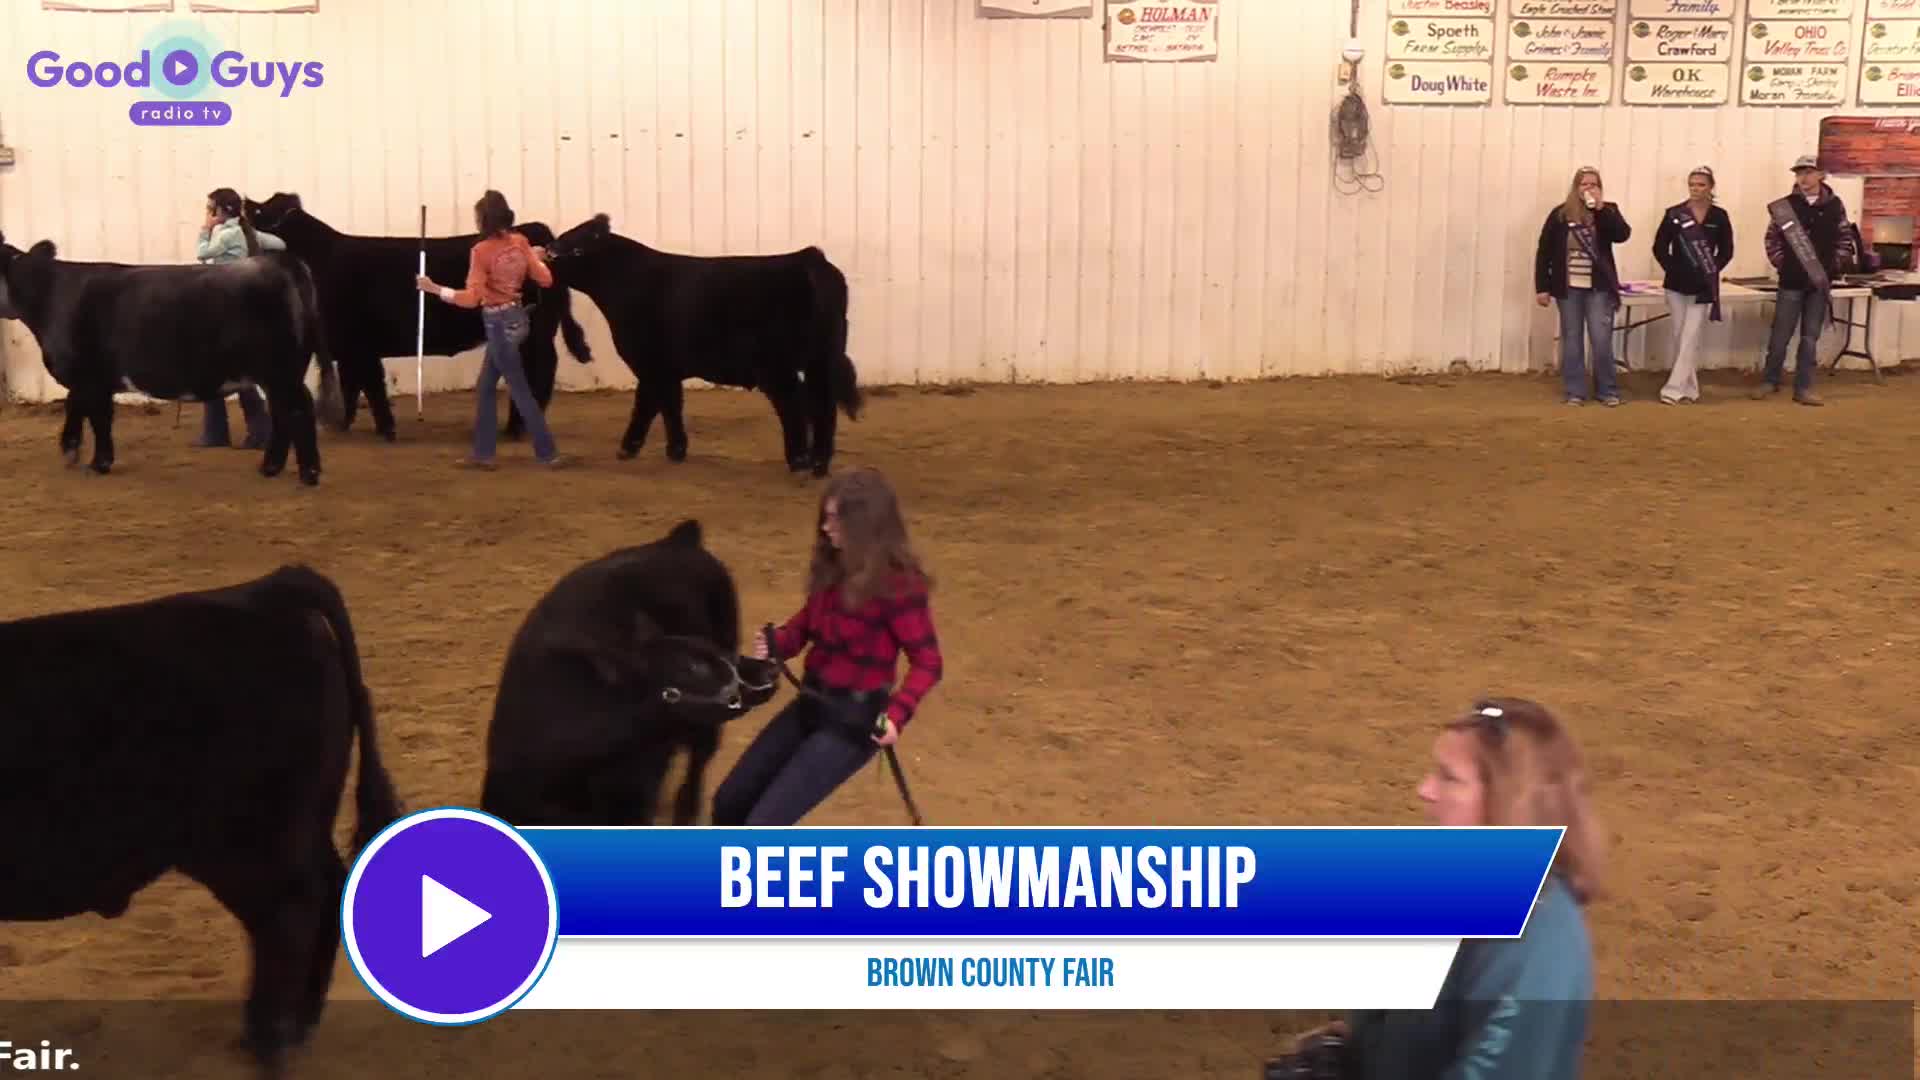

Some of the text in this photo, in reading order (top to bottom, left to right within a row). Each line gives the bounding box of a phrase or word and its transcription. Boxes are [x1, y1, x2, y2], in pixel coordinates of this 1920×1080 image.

[1140, 7, 1212, 22] HOLMAN
[1666, 0, 1721, 15] Family
[1794, 25, 1827, 39] OHIO
[1657, 41, 1717, 56] Crawford
[1411, 74, 1488, 96] Doug White
[1651, 83, 1716, 98] Warehouse
[1750, 88, 1784, 100] Moran
